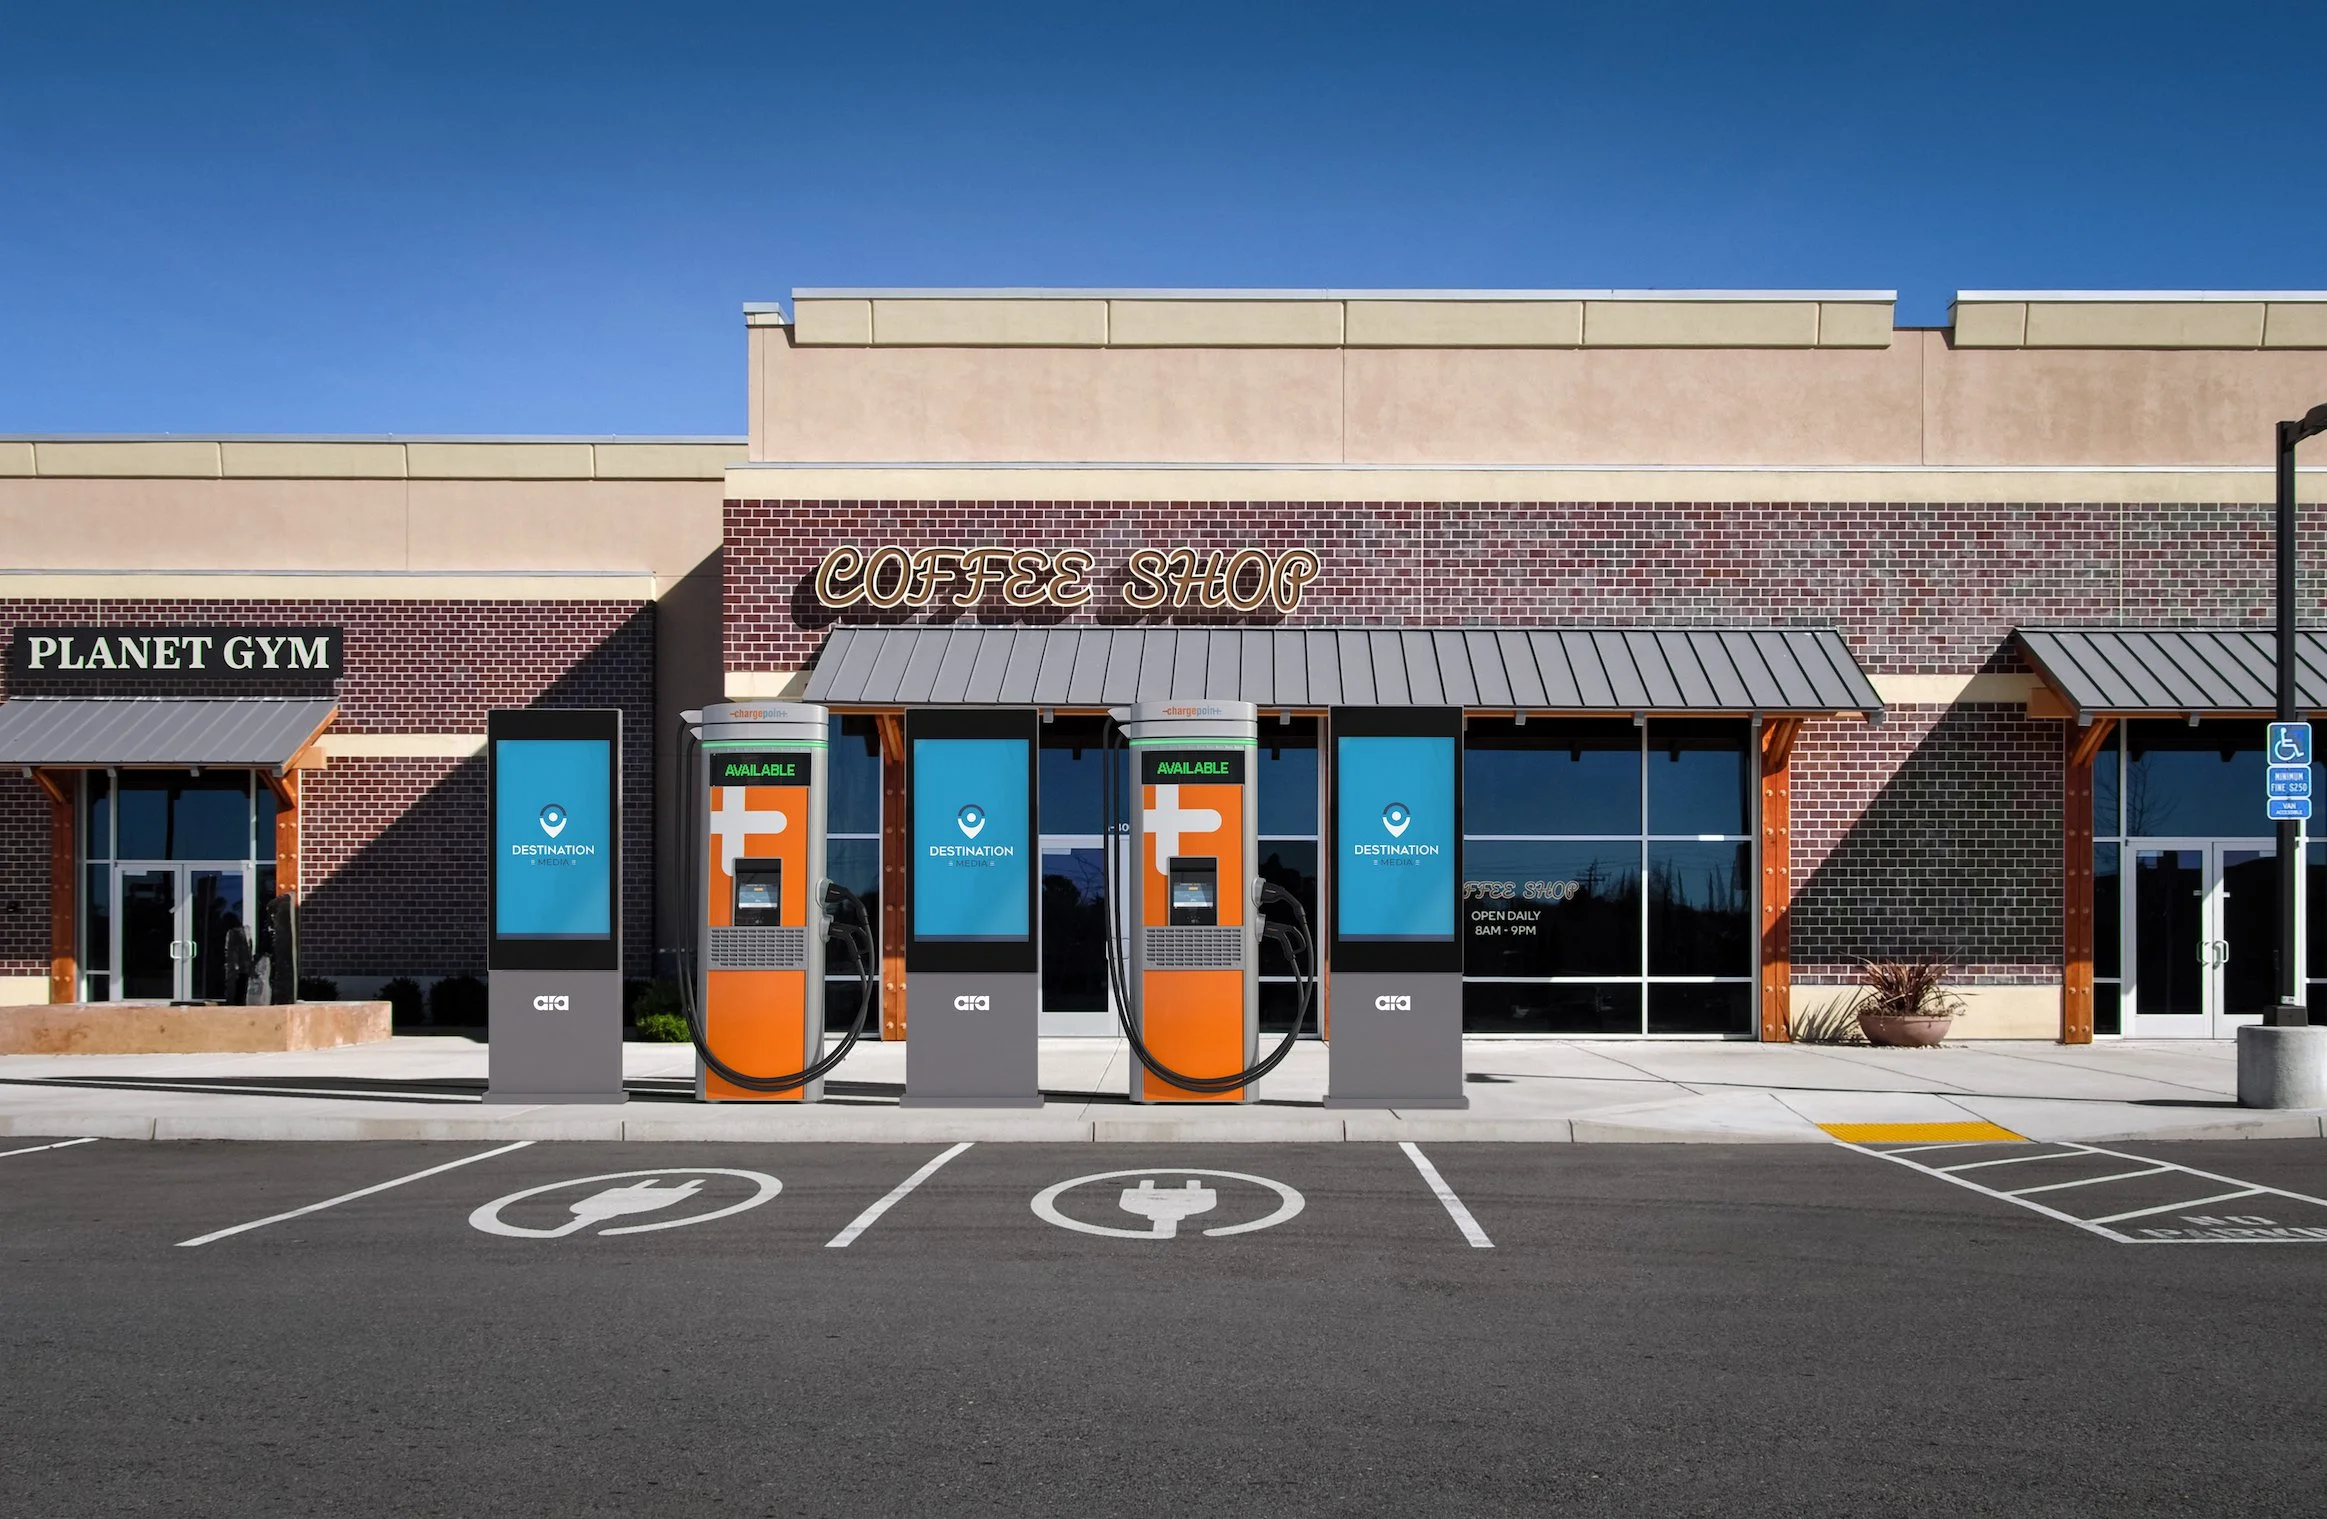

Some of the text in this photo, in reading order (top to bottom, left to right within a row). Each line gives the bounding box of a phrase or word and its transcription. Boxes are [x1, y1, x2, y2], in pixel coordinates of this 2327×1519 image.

[814, 545, 1320, 613] COFFEE SHOP
[27, 635, 330, 670] PLANET GYM
[724, 763, 796, 777] AVAILABLE
[1156, 761, 1230, 775] AVAILABLE
[2270, 783, 2308, 792] FINE $250
[2282, 802, 2297, 810] VAN
[512, 845, 595, 855] DESTINATION
[929, 846, 1014, 857] DESTINATION
[1354, 844, 1439, 855] DESTINATION
[537, 858, 570, 867] MEDIA
[956, 860, 988, 868] MEDIA
[1380, 858, 1414, 867] MEDIA
[1464, 880, 1580, 901] FFEE SHOP
[1471, 911, 1541, 921] OPEN DAILY
[1475, 926, 1501, 936] 8AM
[1511, 926, 1537, 936] 9PM
[2178, 1215, 2278, 1226] NO
